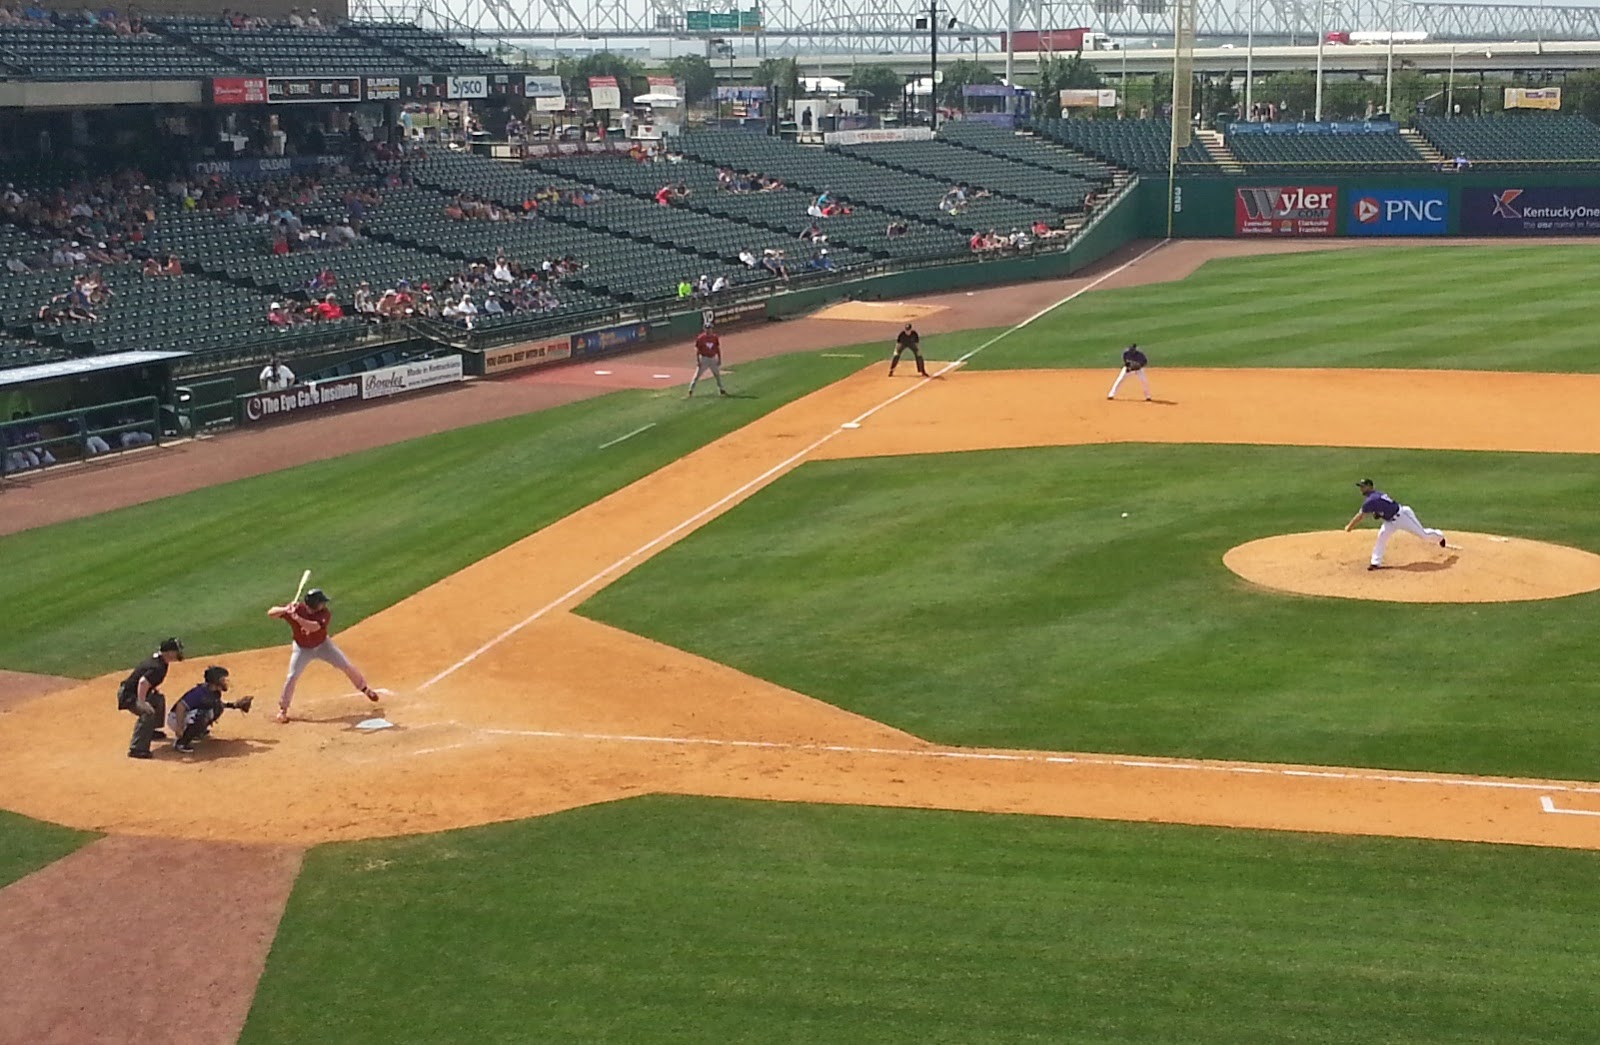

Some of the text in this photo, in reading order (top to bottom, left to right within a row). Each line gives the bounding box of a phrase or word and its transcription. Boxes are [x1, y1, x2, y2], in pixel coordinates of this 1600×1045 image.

[1237, 188, 1333, 220] Wyler
[1384, 199, 1443, 222] PNC
[1523, 206, 1600, 220] KentuckyOne
[365, 371, 406, 391] Bowles
[407, 367, 423, 377] Made
[261, 397, 280, 415] The
[280, 394, 297, 412] Eye
[320, 382, 359, 403] Institute
